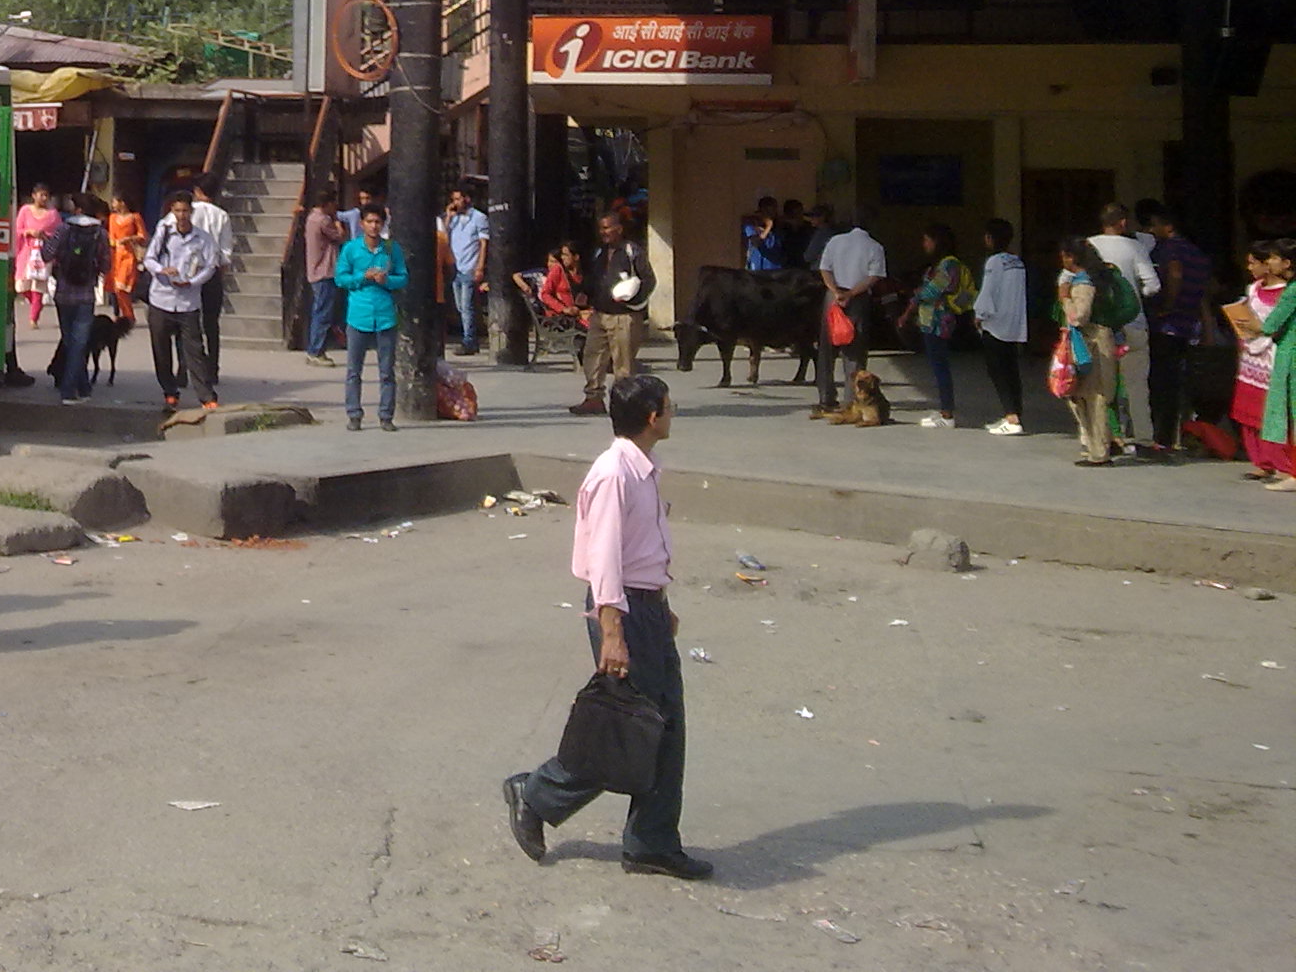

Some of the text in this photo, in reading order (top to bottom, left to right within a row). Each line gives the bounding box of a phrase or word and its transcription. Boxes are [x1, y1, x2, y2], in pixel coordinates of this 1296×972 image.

[613, 21, 640, 42] आई
[640, 20, 658, 40] सी
[658, 21, 685, 42] आई
[686, 21, 704, 40] सी
[704, 21, 733, 42] आई
[602, 49, 755, 69] ICICI Bank
